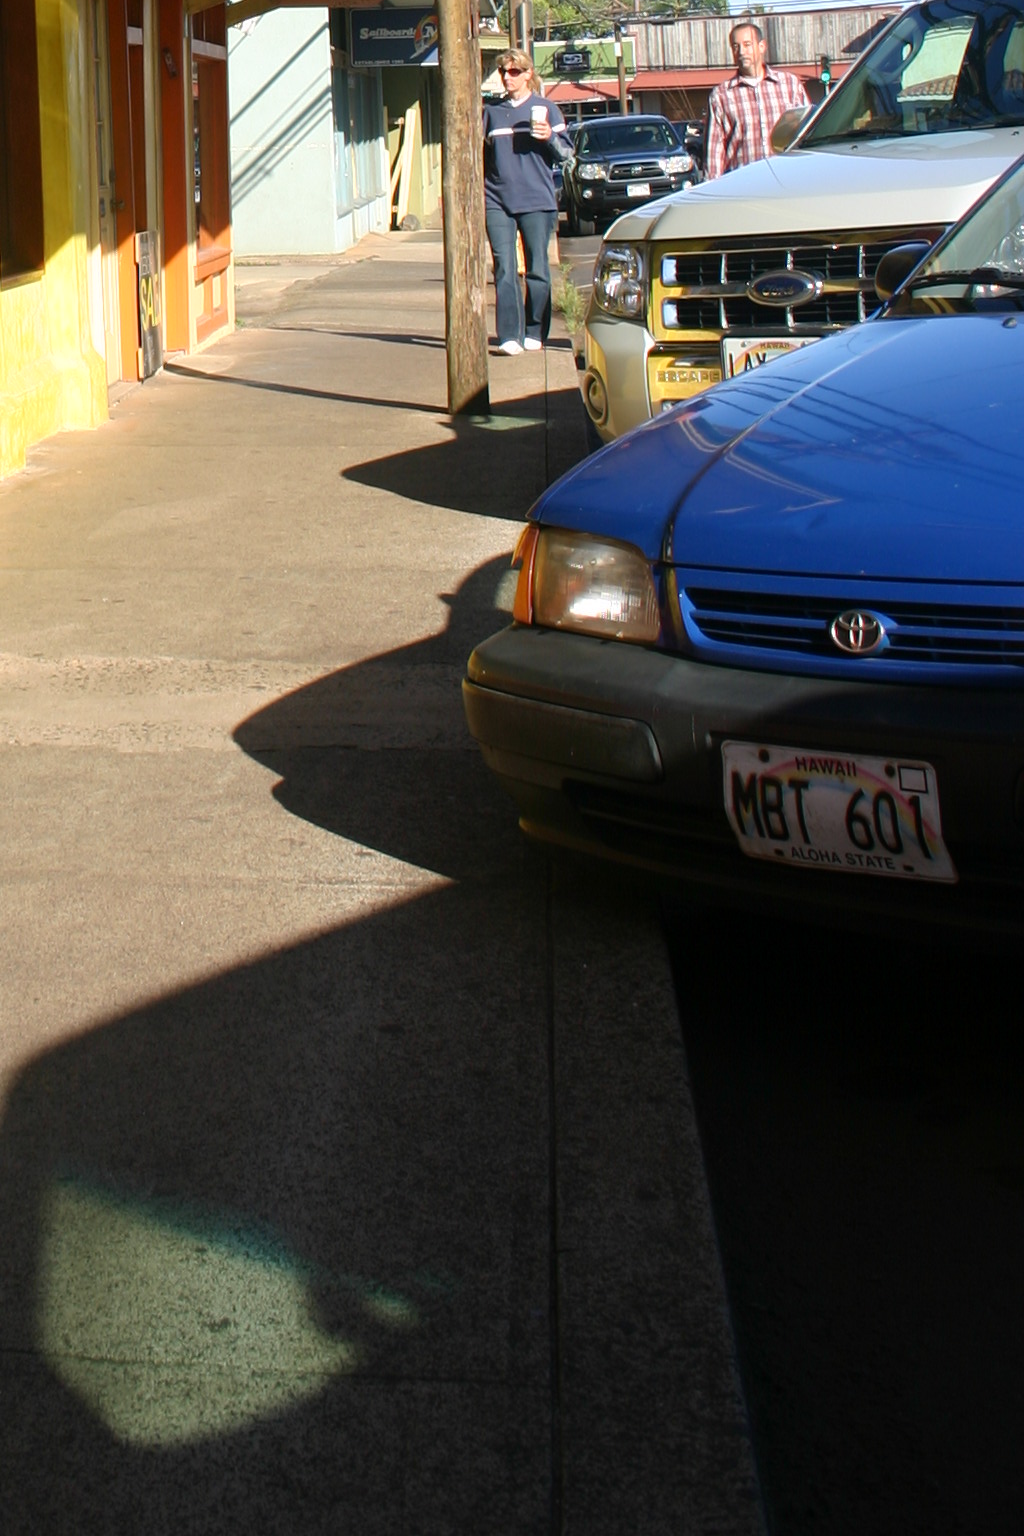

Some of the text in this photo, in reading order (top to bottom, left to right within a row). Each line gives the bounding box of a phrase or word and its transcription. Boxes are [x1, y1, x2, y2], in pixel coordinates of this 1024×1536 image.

[657, 369, 722, 383] ESCAPE
[795, 756, 857, 777] HAWAII
[731, 769, 932, 860] MBT 601
[791, 846, 896, 870] ALOHA STATE
